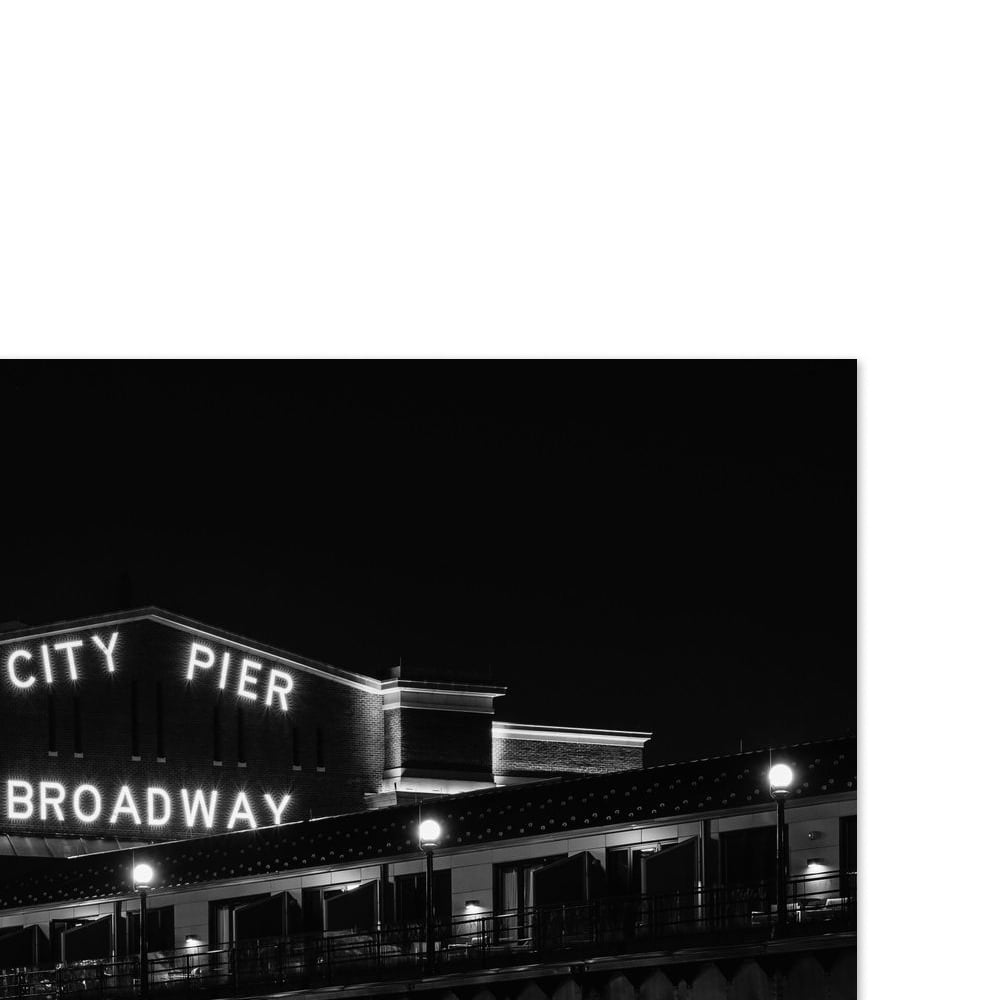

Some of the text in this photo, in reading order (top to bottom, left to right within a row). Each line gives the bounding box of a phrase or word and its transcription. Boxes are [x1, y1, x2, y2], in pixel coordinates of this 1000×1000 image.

[7, 631, 295, 711] CITY PIER
[7, 780, 291, 829] BROADWAY
